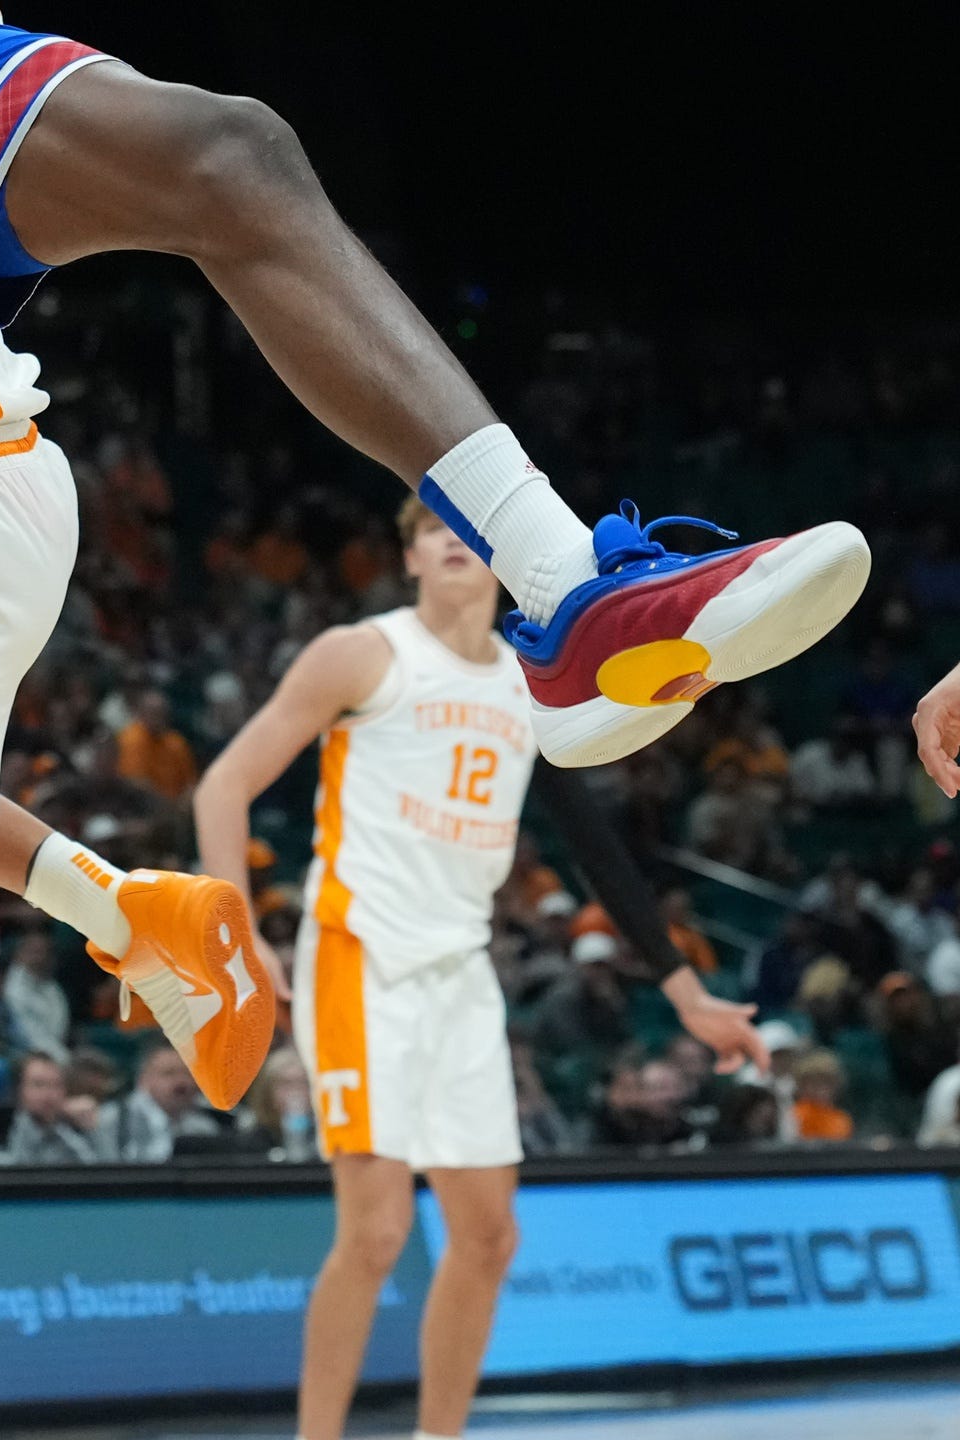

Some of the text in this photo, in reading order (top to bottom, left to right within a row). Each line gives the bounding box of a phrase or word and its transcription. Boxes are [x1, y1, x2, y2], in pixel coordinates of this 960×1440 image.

[446, 742, 499, 807] 12
[320, 1067, 360, 1127] T
[669, 1228, 928, 1312] GEICO
